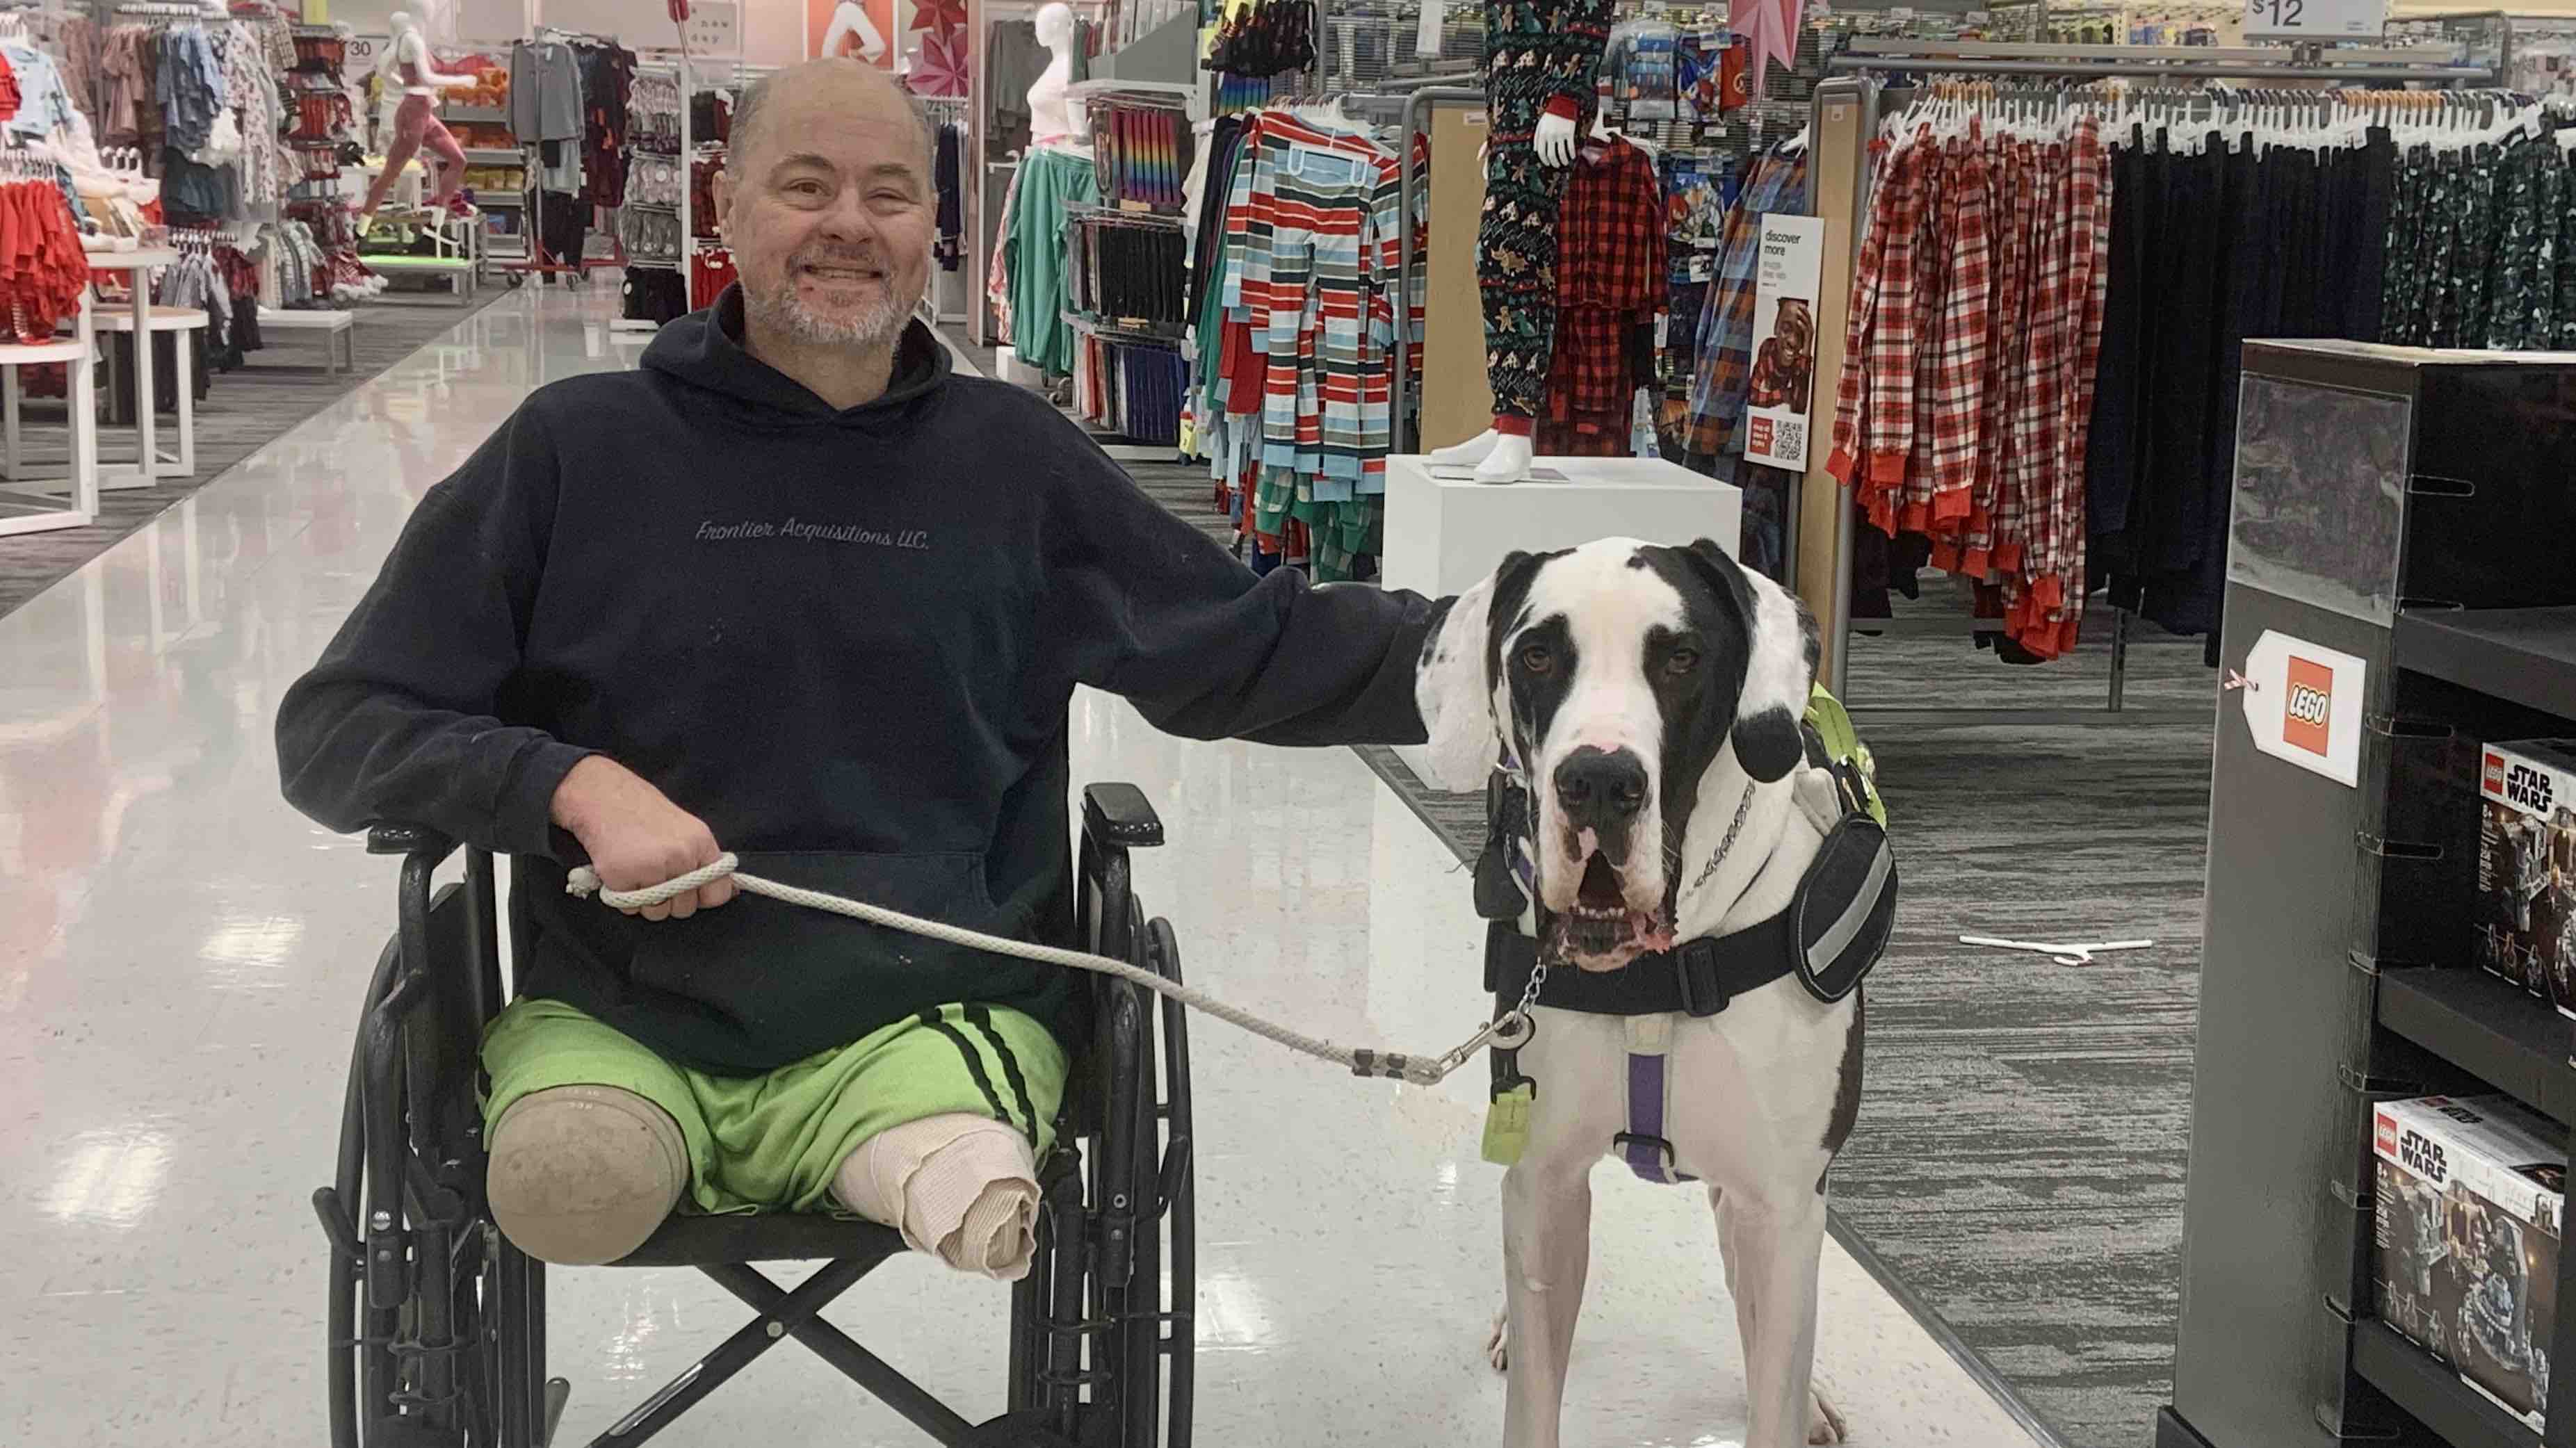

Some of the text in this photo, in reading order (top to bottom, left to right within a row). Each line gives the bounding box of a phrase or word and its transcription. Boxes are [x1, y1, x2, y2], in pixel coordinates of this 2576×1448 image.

[1765, 245, 1785, 256] more
[1766, 229, 1801, 244] discover
[695, 520, 774, 540] Frontier
[779, 517, 891, 546] Acquisitions
[2289, 684, 2327, 726] LEGO
[2507, 764, 2552, 795] STAR
[2507, 781, 2552, 813] WARS
[2400, 1130, 2447, 1167] STAR
[2400, 1144, 2447, 1183] WARS
